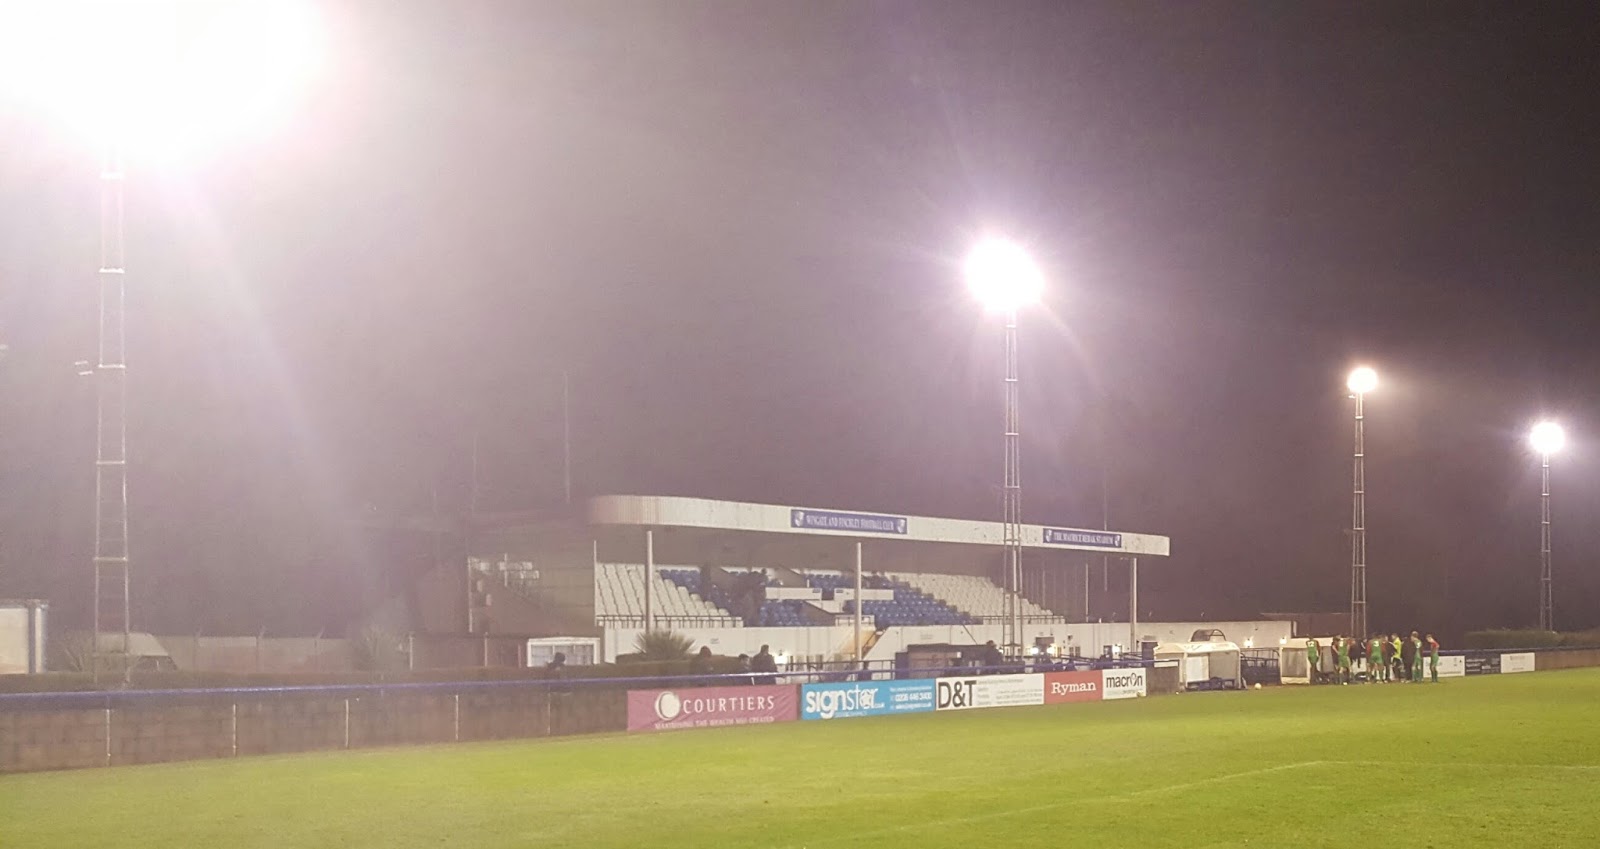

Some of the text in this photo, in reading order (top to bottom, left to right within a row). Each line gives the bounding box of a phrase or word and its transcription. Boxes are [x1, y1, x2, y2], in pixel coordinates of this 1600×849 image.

[828, 517, 838, 527] AND
[1053, 532, 1062, 541] THE
[1106, 672, 1143, 688] macron
[938, 680, 977, 709] D&T
[1051, 682, 1097, 695] Ryman
[683, 696, 775, 714] COURTIERS
[806, 684, 878, 719] signstar
